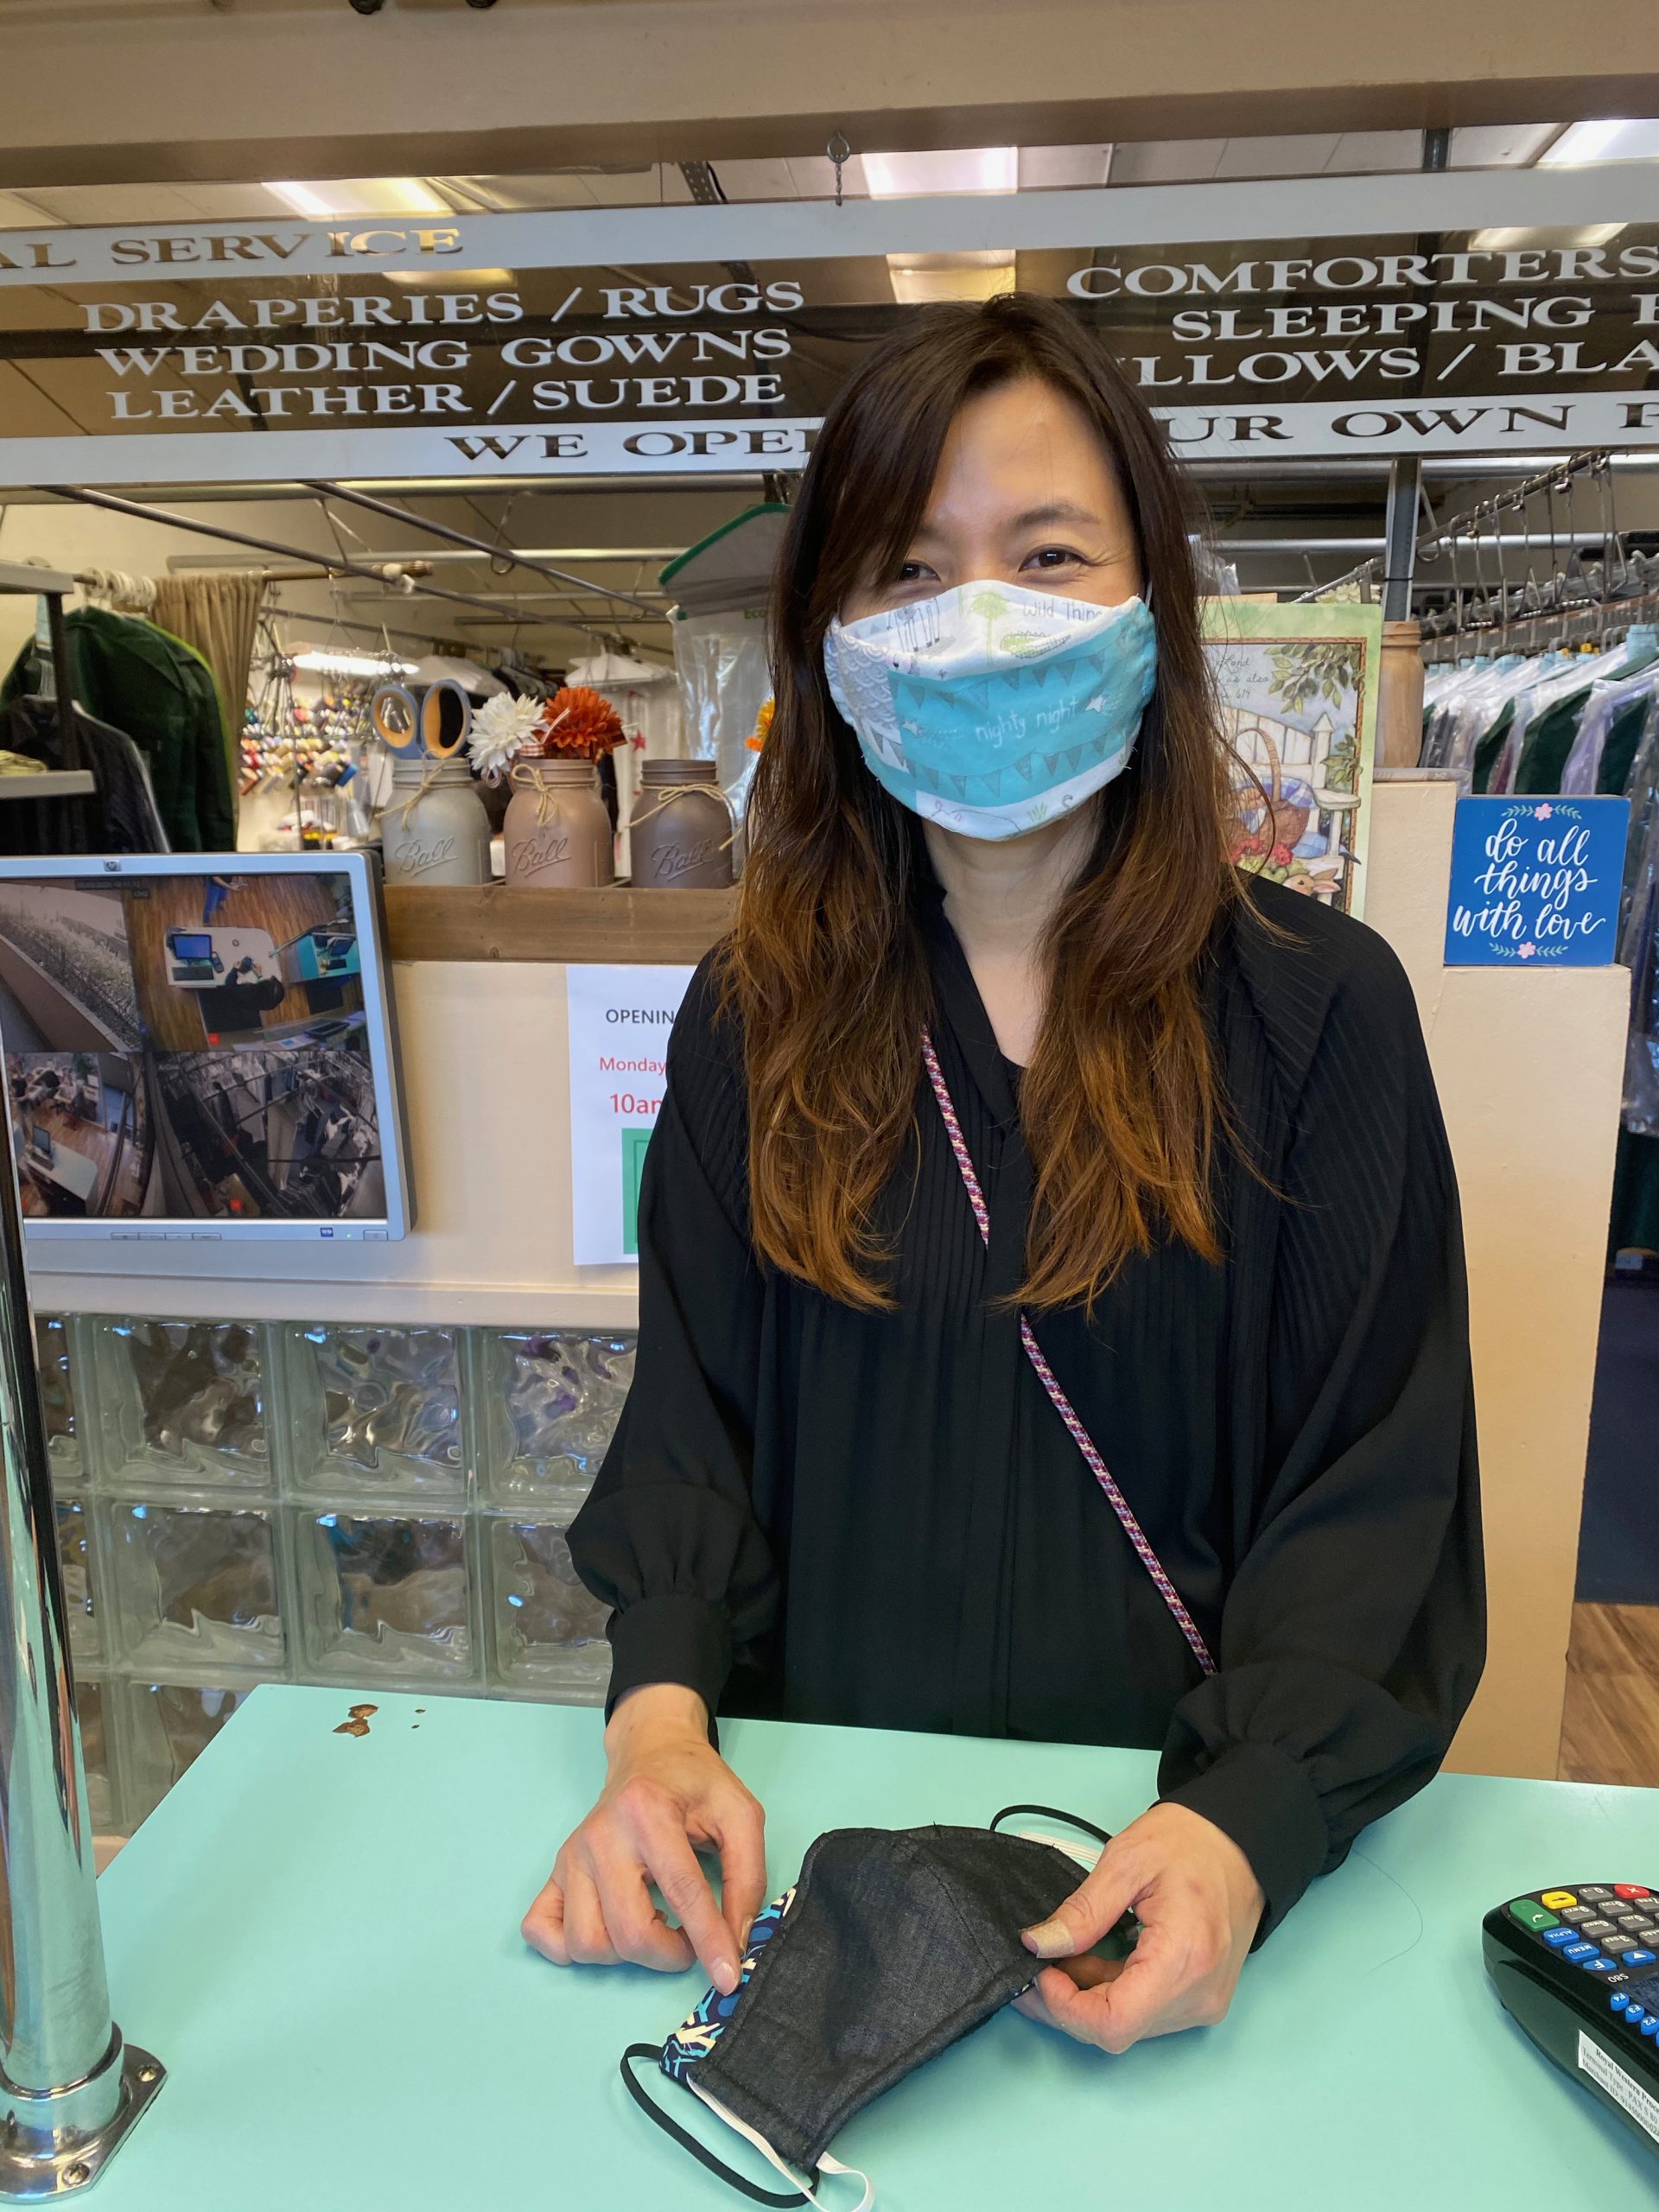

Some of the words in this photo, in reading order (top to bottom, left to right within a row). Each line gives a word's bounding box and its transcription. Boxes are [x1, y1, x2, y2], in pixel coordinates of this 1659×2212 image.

[110, 228, 463, 264] SERVICE
[1066, 245, 1659, 298] COMFORTERS
[79, 292, 524, 334] DRAPERIES
[600, 281, 804, 319] RUGS
[1172, 296, 1595, 342] SLEEPING
[94, 338, 470, 378] WEDDING
[500, 328, 791, 368] GOWNS
[1116, 346, 1420, 387] LLOWS
[106, 383, 473, 419] LEATHER
[532, 373, 785, 410] SUEDE
[443, 433, 588, 461] WE
[1331, 404, 1576, 438] OWN
[976, 709, 1026, 748] nighty
[1037, 696, 1079, 734] night
[395, 836, 457, 877] Ball
[512, 836, 571, 878] Ball
[652, 838, 715, 881] Ball
[1484, 817, 1529, 861] do
[1536, 825, 1591, 867] all
[1473, 861, 1598, 910] things
[1452, 899, 1527, 940] with
[1534, 906, 1606, 940] love
[606, 1008, 674, 1025] OPENIN
[600, 1057, 667, 1076] Monday
[1548, 1929, 1573, 1938] ALPHA
[1567, 1944, 1592, 1954] MENU
[1608, 1973, 1630, 1983] S80
[1629, 2005, 1641, 2013] F3
[1643, 2017, 1656, 2026] F2
